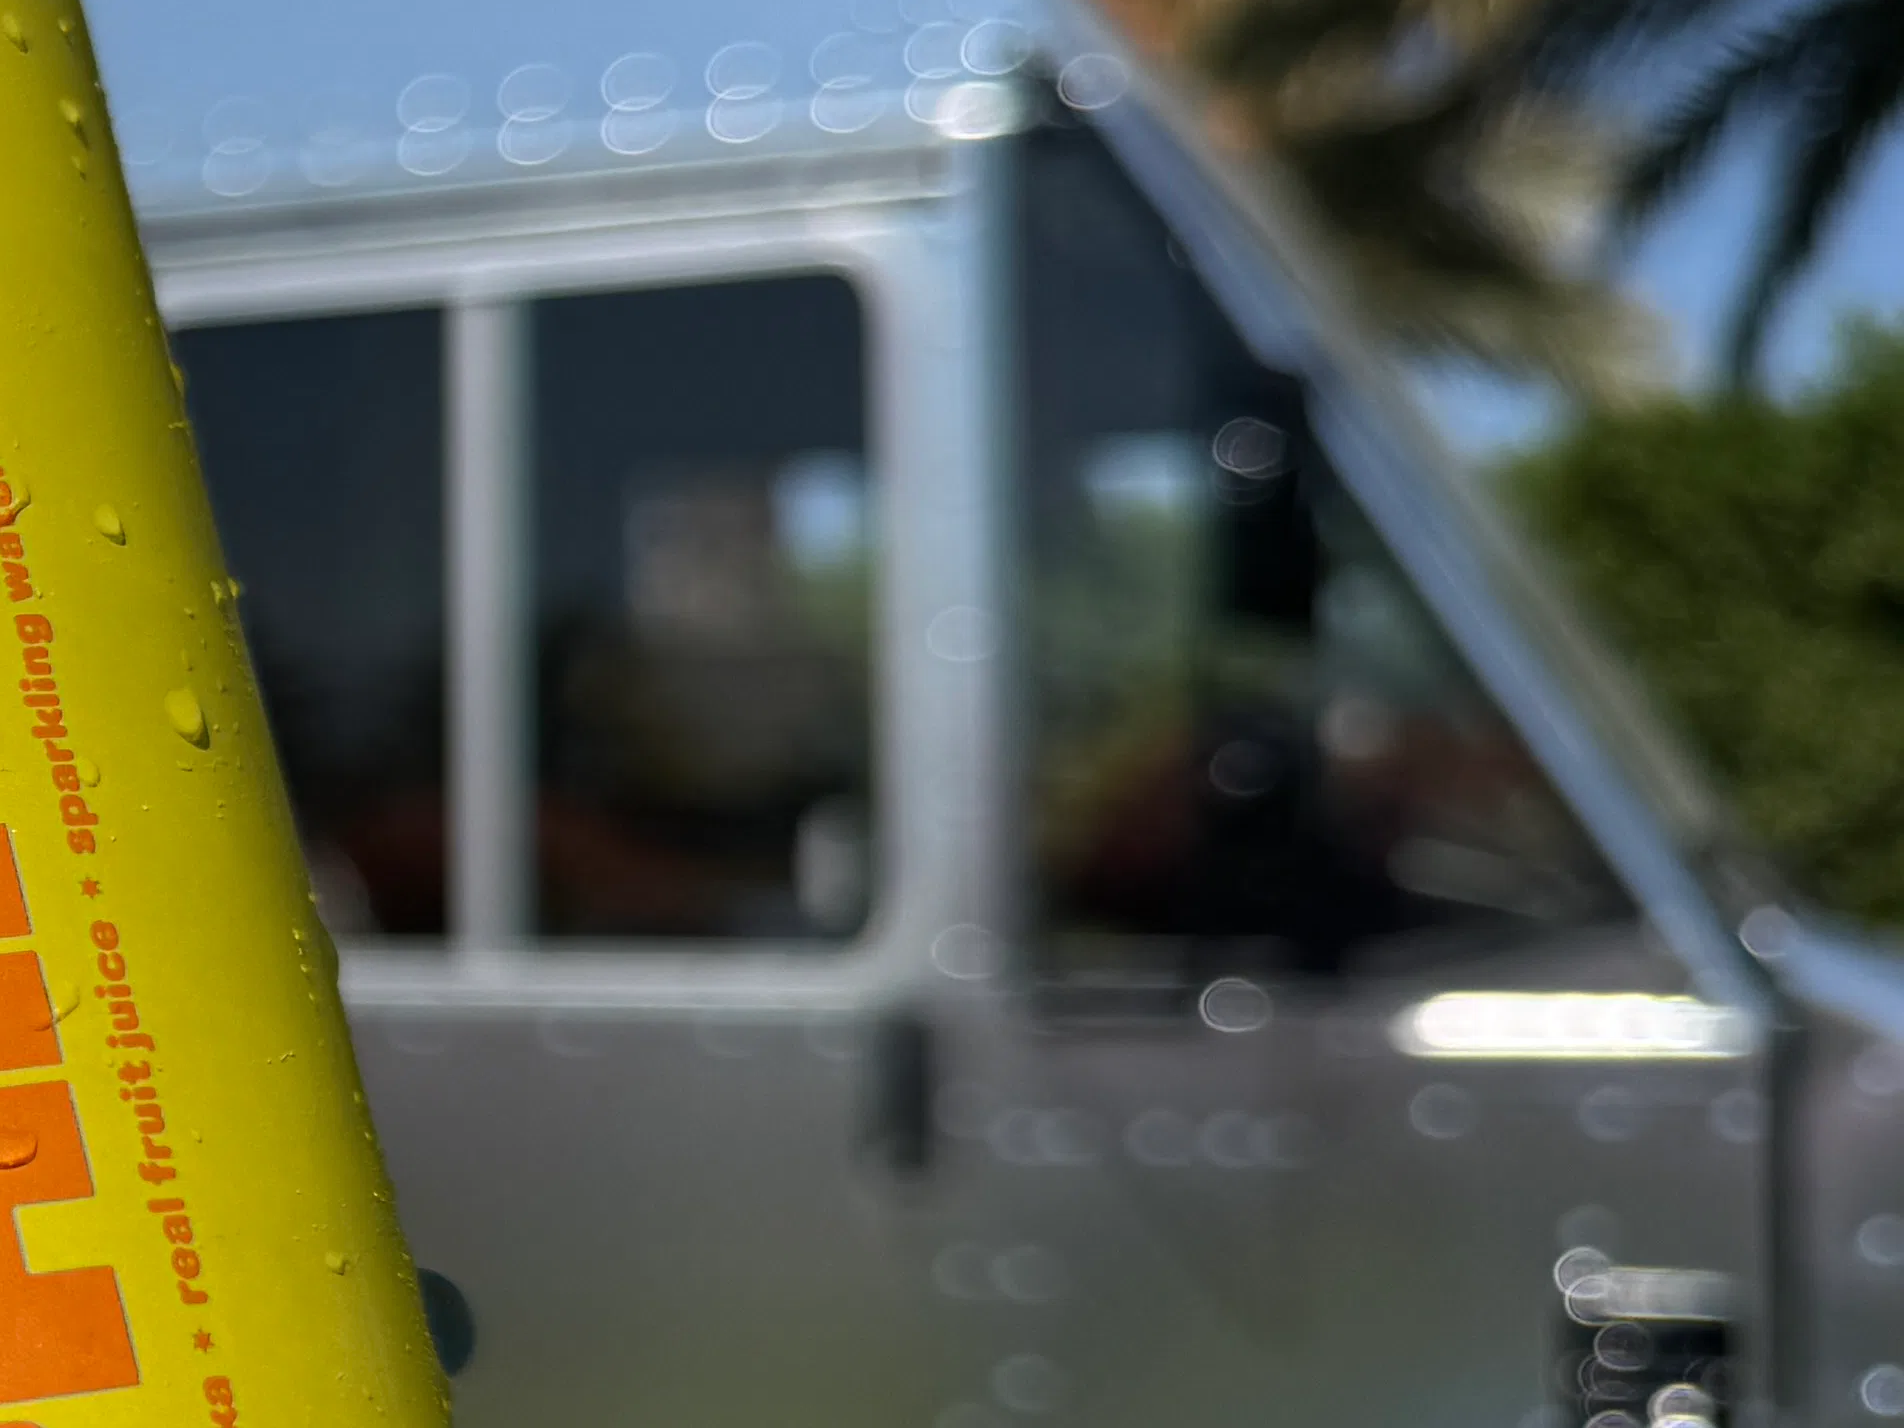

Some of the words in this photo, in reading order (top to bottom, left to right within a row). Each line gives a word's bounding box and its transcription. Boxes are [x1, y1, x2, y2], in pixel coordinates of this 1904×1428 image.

[14, 612, 101, 855] sparkling
[90, 919, 157, 1053] juice
[118, 1059, 178, 1186] fruit
[146, 1197, 210, 1306] real
